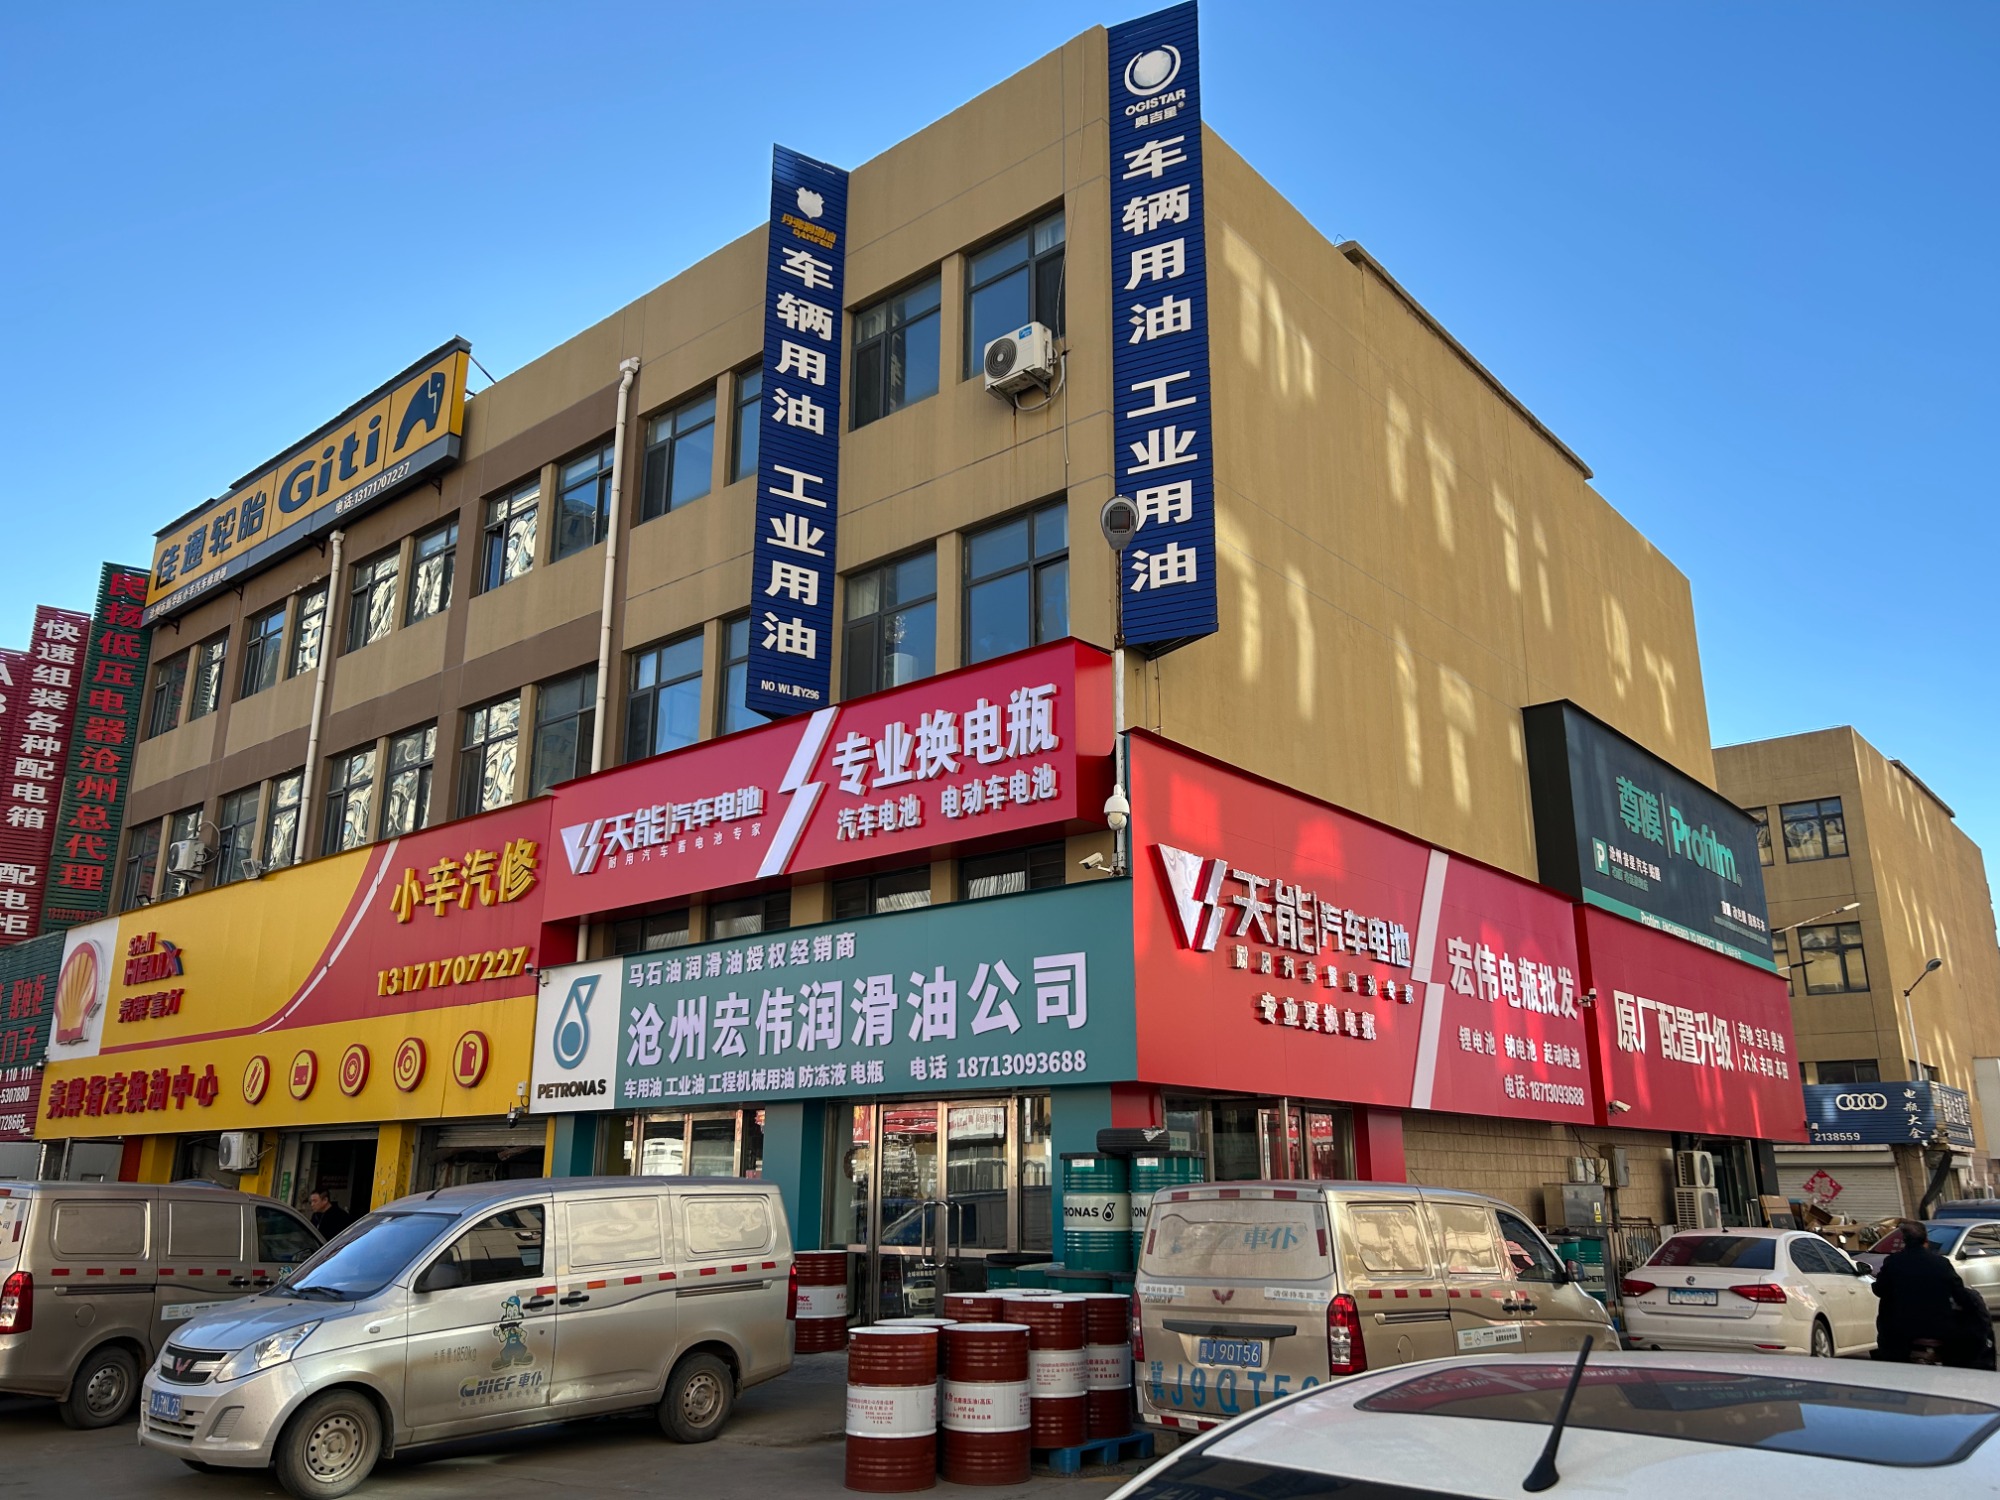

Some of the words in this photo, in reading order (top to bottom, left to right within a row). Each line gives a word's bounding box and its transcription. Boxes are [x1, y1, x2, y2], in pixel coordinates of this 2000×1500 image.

[1125, 89, 1186, 116] OGISTAR
[1134, 106, 1178, 129] 奥吉星
[1122, 135, 1192, 345] 车辆用油
[771, 246, 834, 436] 车辆用油
[278, 415, 382, 514] Giti
[1126, 370, 1198, 592] 工业用油
[155, 490, 267, 590] 佳通轮胎
[761, 464, 827, 659] 工业用油
[6, 619, 81, 830] 快速组装各种配电箱
[58, 573, 149, 892] 民扬低压电器沧州总代理
[832, 683, 1059, 796] 专业换电瓶
[603, 805, 667, 855] 天能
[671, 786, 763, 834] 汽车电池
[837, 794, 921, 841] 汽车电池
[940, 762, 1057, 818] 电动车电池
[390, 838, 538, 923] 小辛汽修
[608, 822, 762, 869] 耐用汽车蓄电池专家
[1669, 805, 1738, 887] Profilm
[1231, 868, 1315, 955] 天能
[1319, 900, 1411, 967] 汽车电池
[378, 946, 531, 996] 13171707227
[628, 932, 857, 989] 马石油润滑油授权经销商
[1447, 936, 1578, 1020] 宏伟电瓶批发
[0, 1025, 38, 1064] 门子
[626, 952, 1088, 1067] 沧州宏伟润滑油公司
[1259, 991, 1376, 1040] 专业更换电瓶
[1459, 1025, 1496, 1056] 锂电池
[1613, 989, 1734, 1071] 原厂配置升级
[1754, 1027, 1770, 1050] 宝马
[46, 1063, 219, 1119] 壳牌指定换油中心
[537, 1079, 606, 1099] PETRONAS
[624, 1077, 662, 1099] 车用油
[665, 1073, 706, 1096] 工业油
[708, 1066, 795, 1094] 工程机械用油
[798, 1063, 847, 1088] 防冻液
[850, 1059, 884, 1084] 电瓶
[910, 1054, 948, 1080] 电话
[957, 1049, 1086, 1078] 18713093688
[1742, 1050, 1758, 1074] 大众
[1759, 1054, 1774, 1077] 丰田
[1774, 1057, 1789, 1080] 本田
[1815, 1131, 1861, 1142] 2138559
